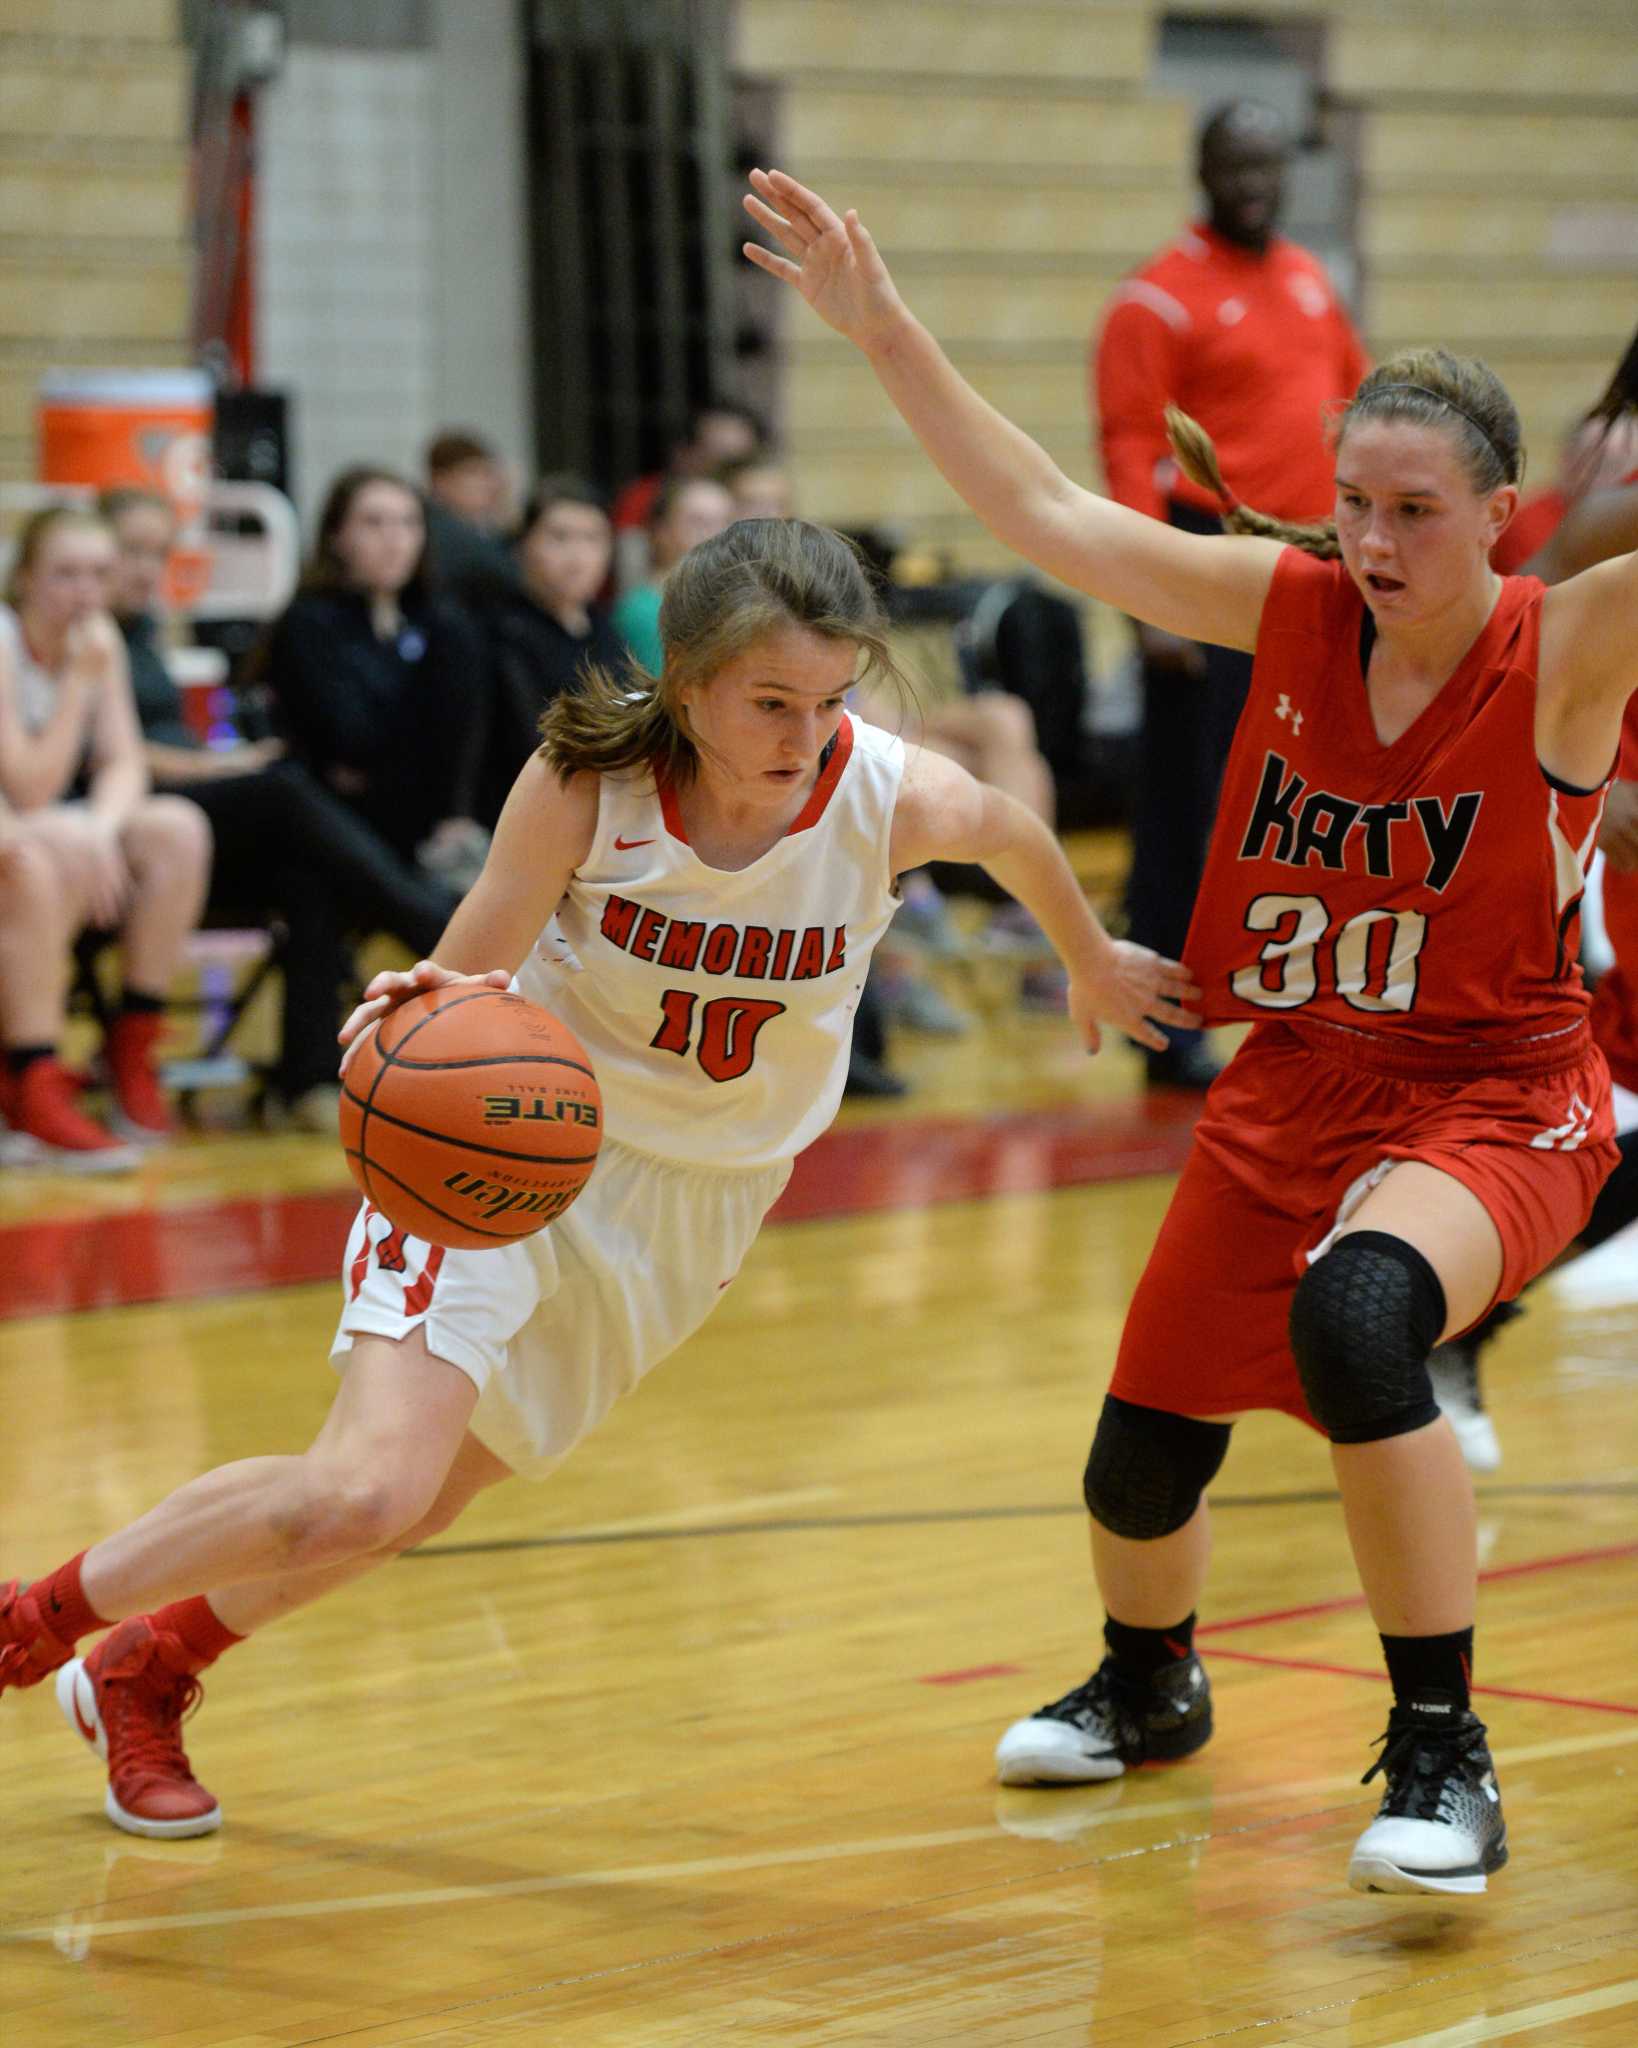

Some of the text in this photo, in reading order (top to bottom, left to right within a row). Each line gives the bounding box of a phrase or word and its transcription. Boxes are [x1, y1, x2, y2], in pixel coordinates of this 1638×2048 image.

[1238, 750, 1484, 895] KATY
[600, 894, 847, 981] MEMORIAL
[1228, 892, 1429, 1013] 30
[649, 988, 787, 1083] 10
[484, 1097, 598, 1128] ELITE
